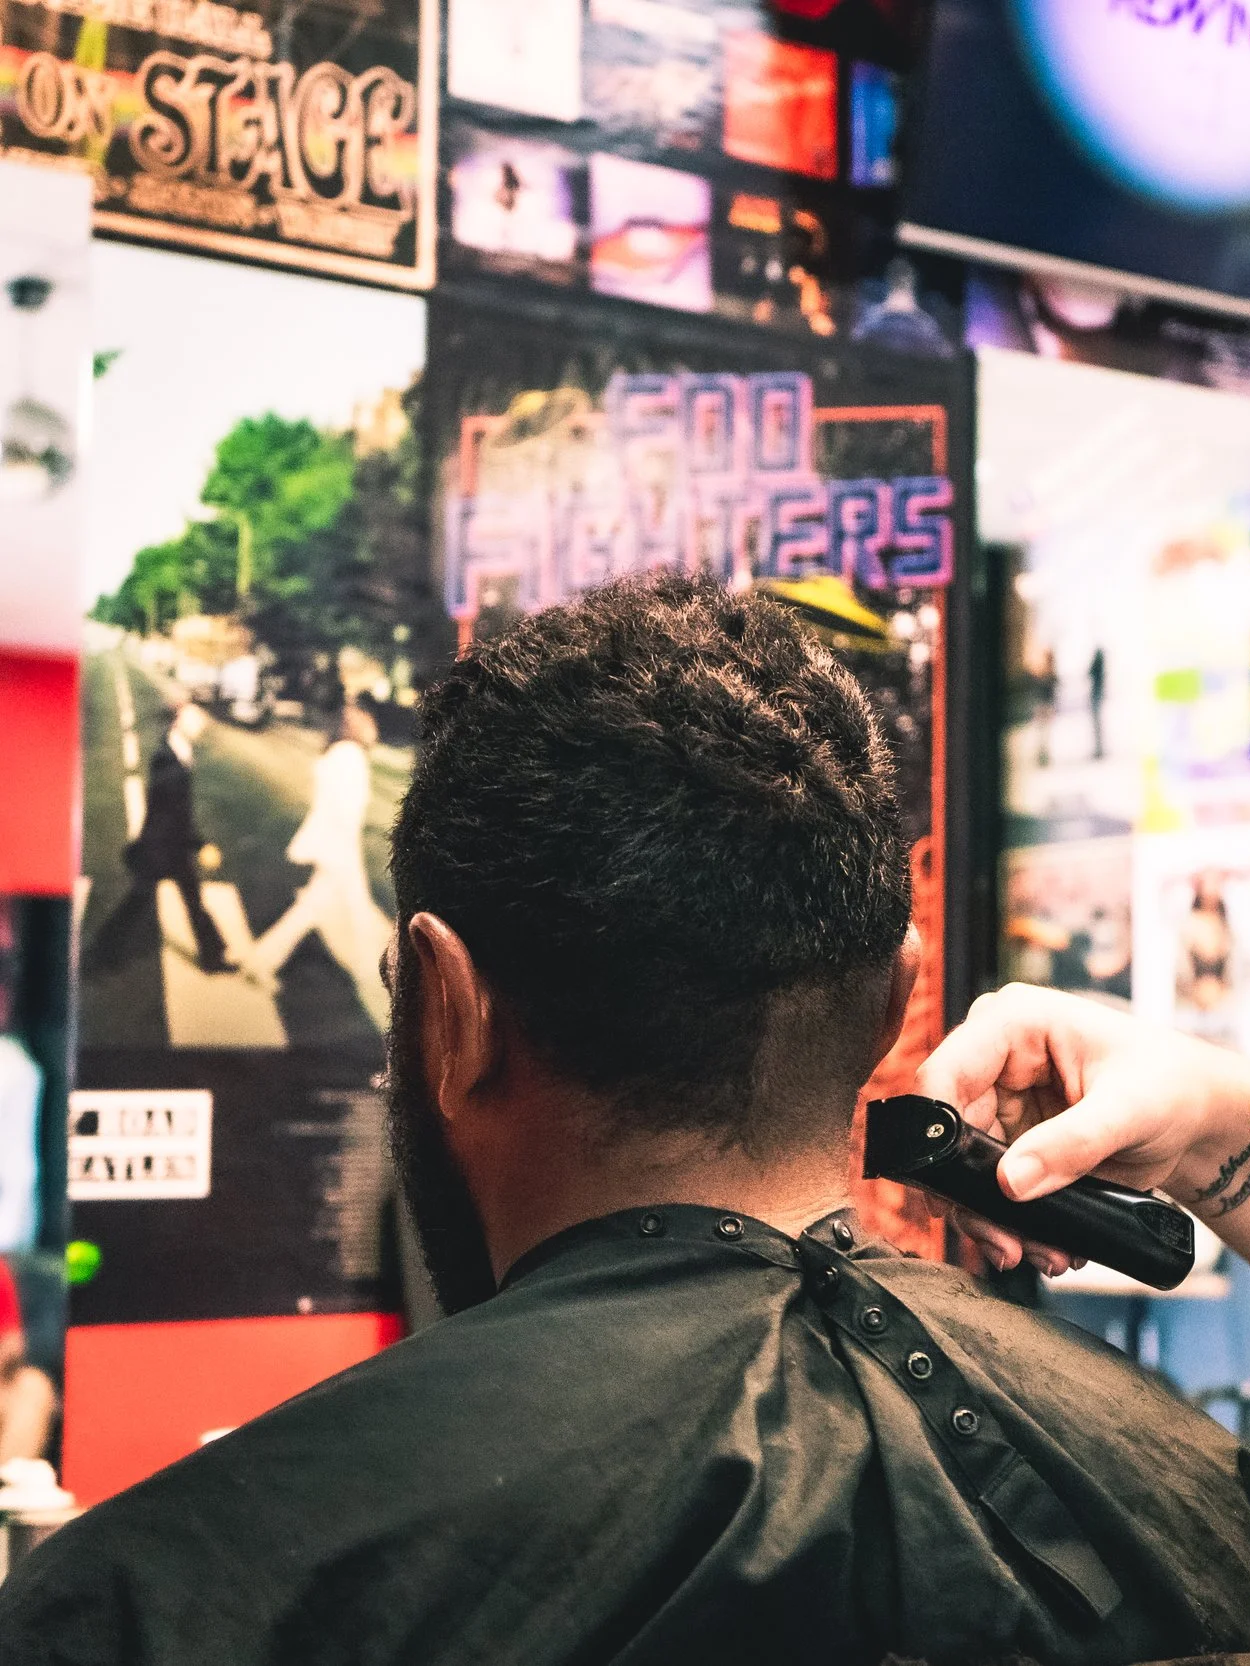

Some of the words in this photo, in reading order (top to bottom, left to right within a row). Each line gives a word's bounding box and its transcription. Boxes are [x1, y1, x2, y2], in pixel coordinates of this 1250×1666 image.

[130, 50, 417, 214] STAGE
[604, 370, 813, 482] FOO
[446, 474, 954, 619] FIGHTERS
